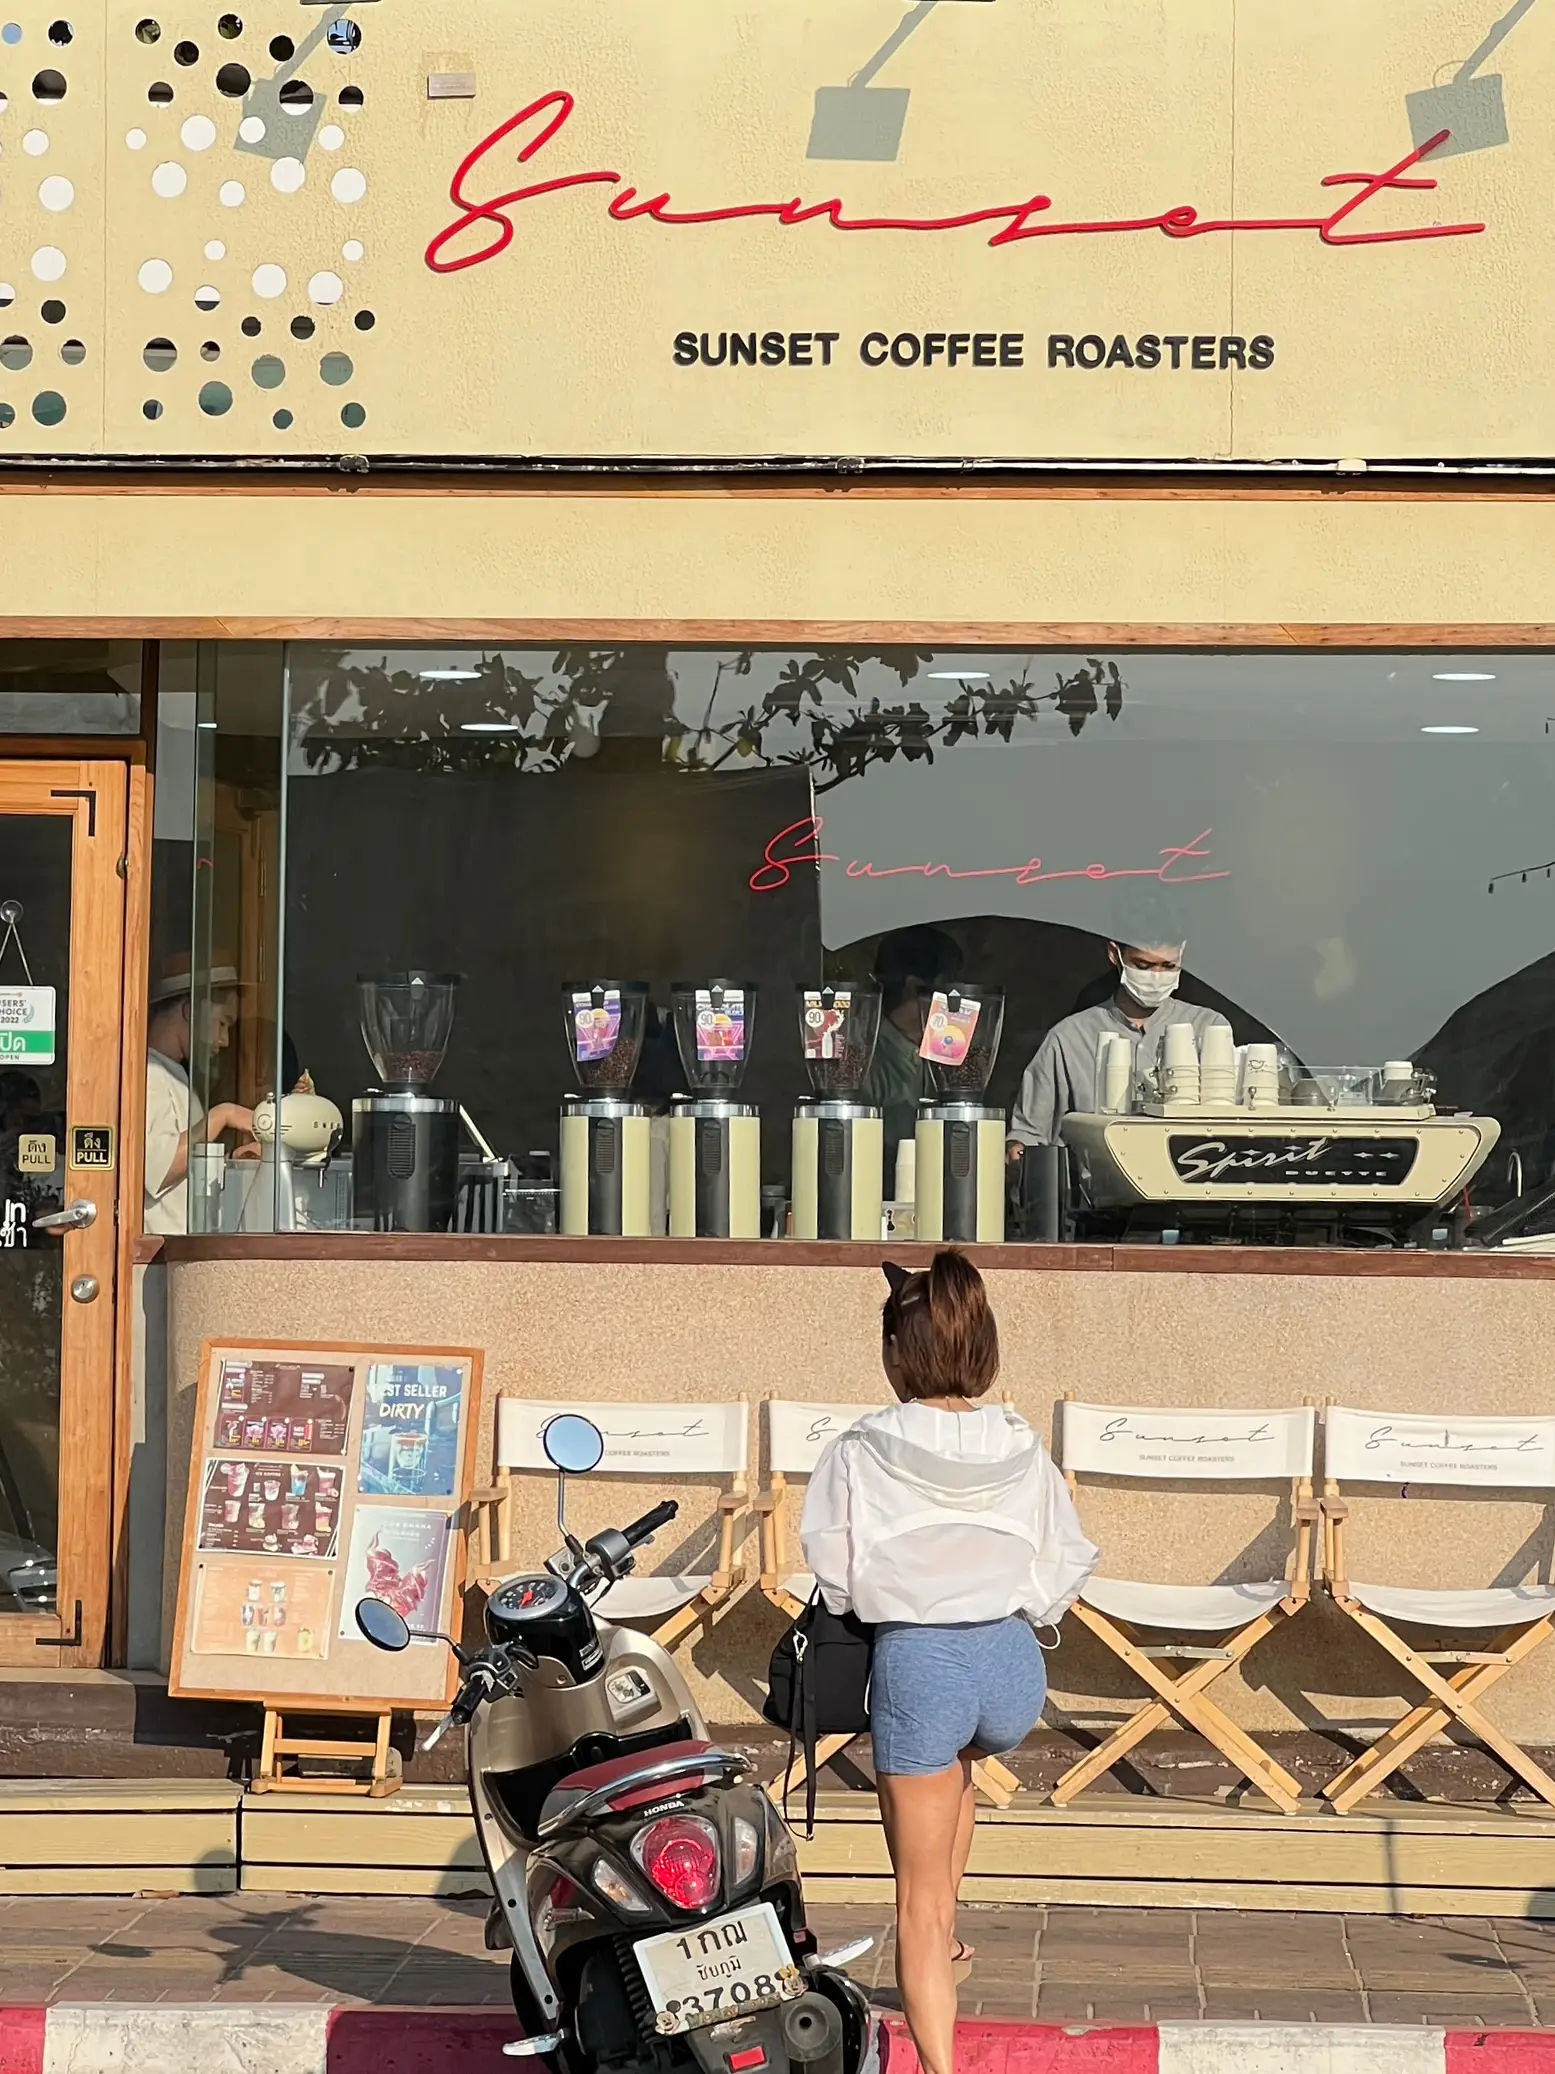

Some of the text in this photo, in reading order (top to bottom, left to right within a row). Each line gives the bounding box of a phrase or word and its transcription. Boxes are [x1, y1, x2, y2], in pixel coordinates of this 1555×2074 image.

[425, 90, 1486, 273] Sunset
[674, 332, 1275, 370] SUNSET COFFEE ROASTERS
[749, 816, 1230, 891] Sunset
[0, 999, 27, 1007] SERS'
[0, 1008, 27, 1016] HOICE
[701, 1013, 713, 1026] 90
[809, 1011, 821, 1024] 90
[0, 1031, 26, 1051] ปิด
[22, 1154, 51, 1164] PULL
[77, 1151, 107, 1163] PULL
[1178, 1137, 1332, 1181] Spirit
[404, 1384, 447, 1398] SELLER
[379, 1402, 425, 1420] DIRTY
[1100, 1417, 1275, 1443] Sunset
[1365, 1426, 1544, 1451] Sunset
[1459, 1463, 1498, 1471] ROASTERS
[643, 1800, 685, 1817] HONDA
[696, 1954, 741, 1981] ชัยภูมิ
[682, 1974, 776, 2013] 3708
